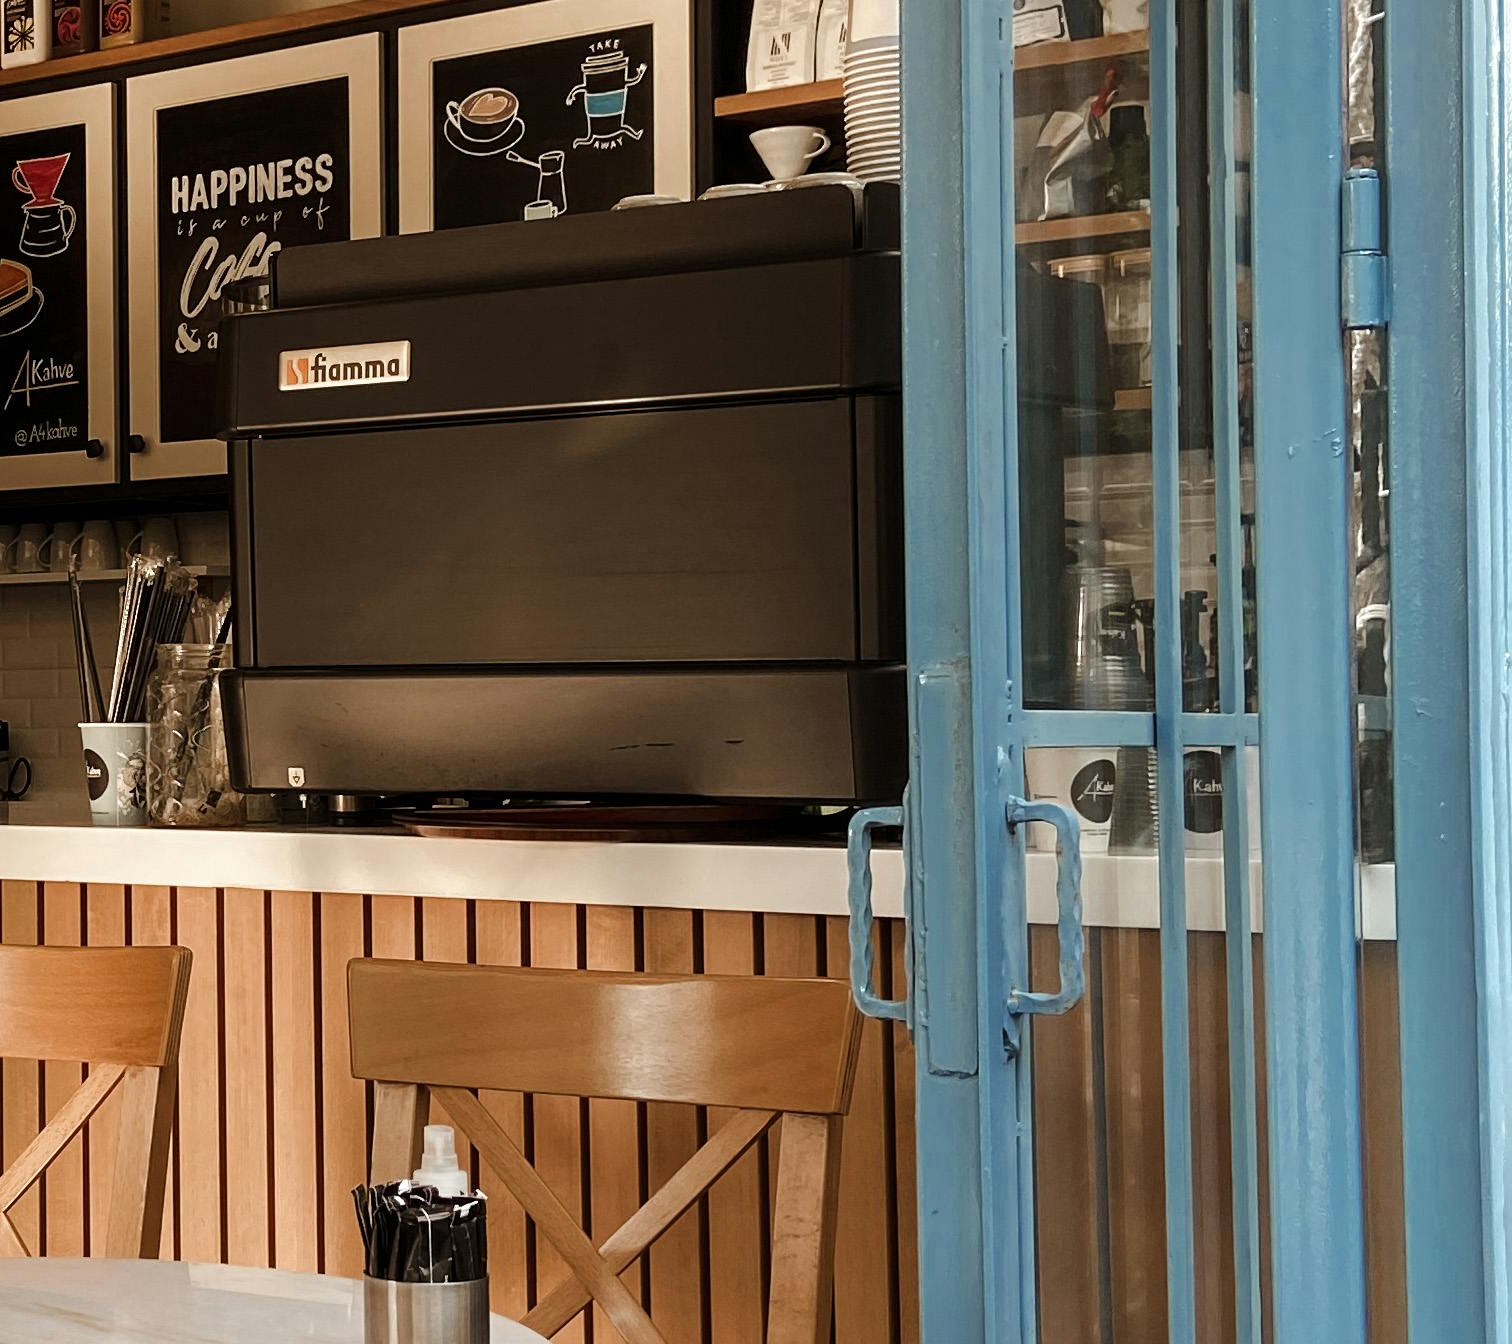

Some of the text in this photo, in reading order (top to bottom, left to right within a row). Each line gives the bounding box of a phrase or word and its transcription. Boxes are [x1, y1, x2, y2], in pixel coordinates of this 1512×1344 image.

[588, 39, 620, 53] TAKE
[592, 137, 624, 150] AWAY
[171, 153, 333, 215] HAPPINESS
[177, 197, 331, 237] is a cup of
[180, 231, 282, 319] Coff
[174, 322, 202, 354] &
[32, 357, 75, 385] Kahve
[311, 353, 400, 383] fiamma
